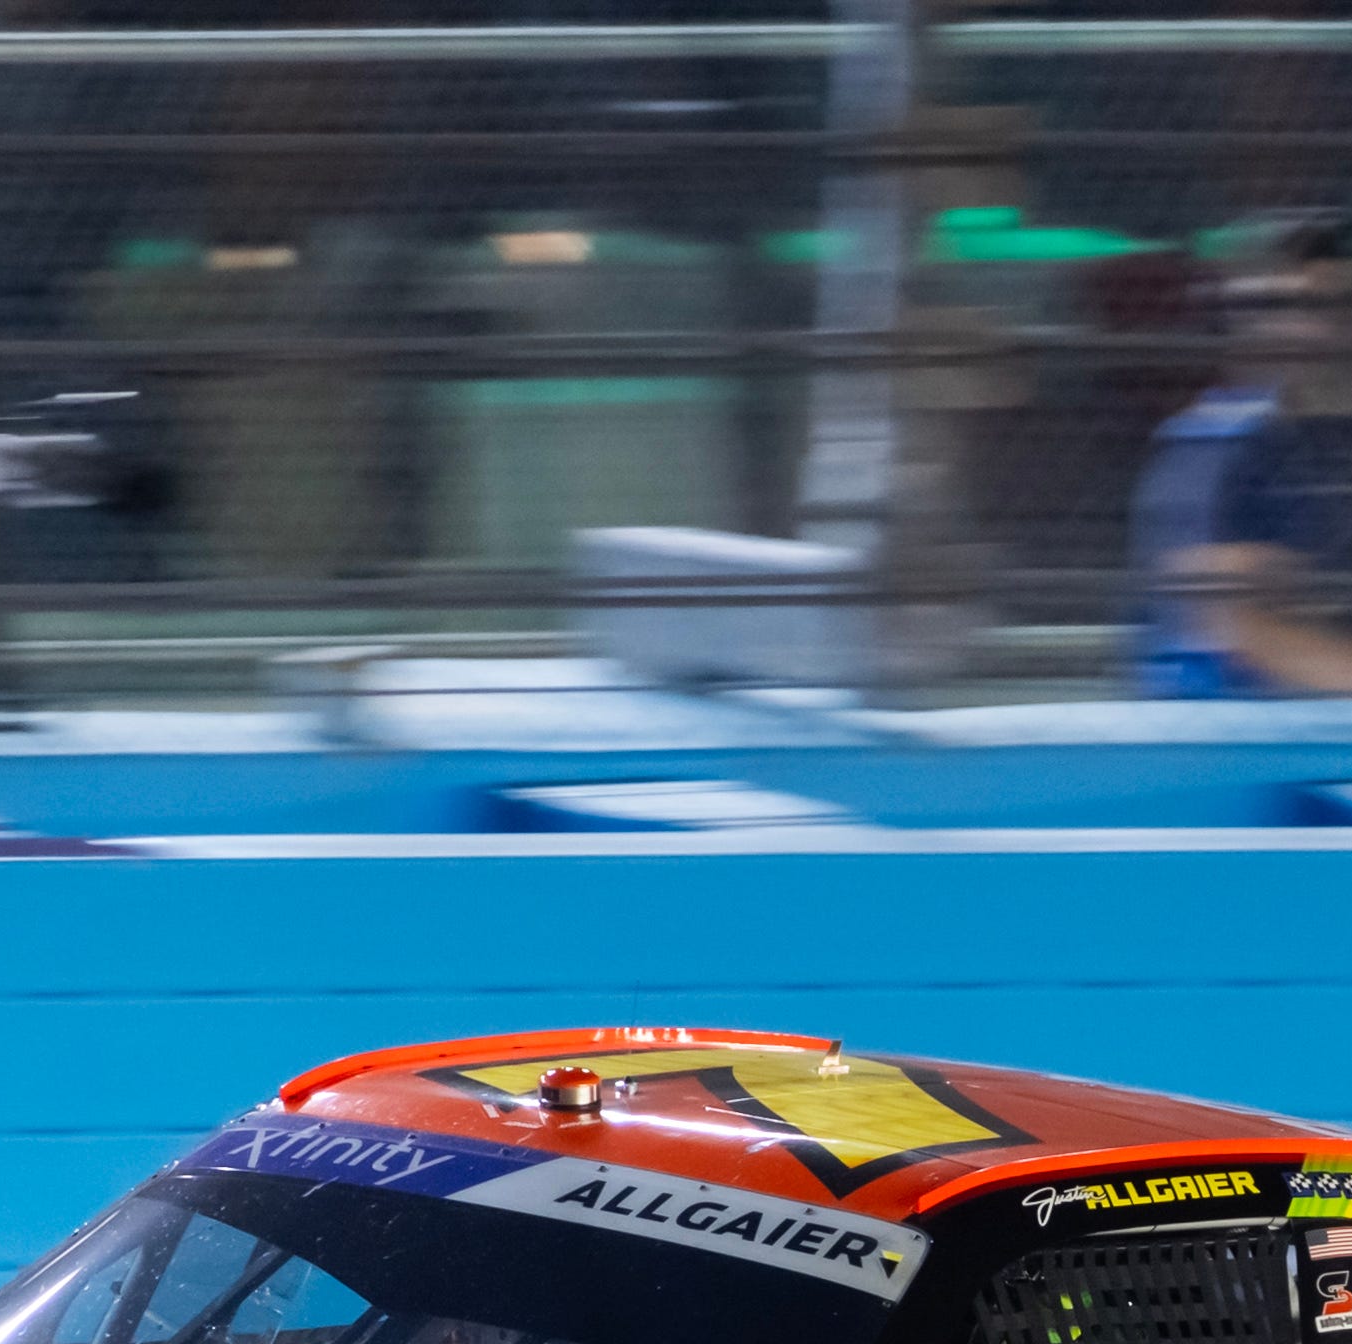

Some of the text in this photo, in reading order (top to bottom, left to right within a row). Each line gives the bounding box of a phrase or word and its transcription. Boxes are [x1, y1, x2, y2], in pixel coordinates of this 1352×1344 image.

[224, 1122, 456, 1186] xfinity
[554, 1179, 879, 1269] ALLGAIER
[1022, 1171, 1261, 1226] Justin ALLGAIER
